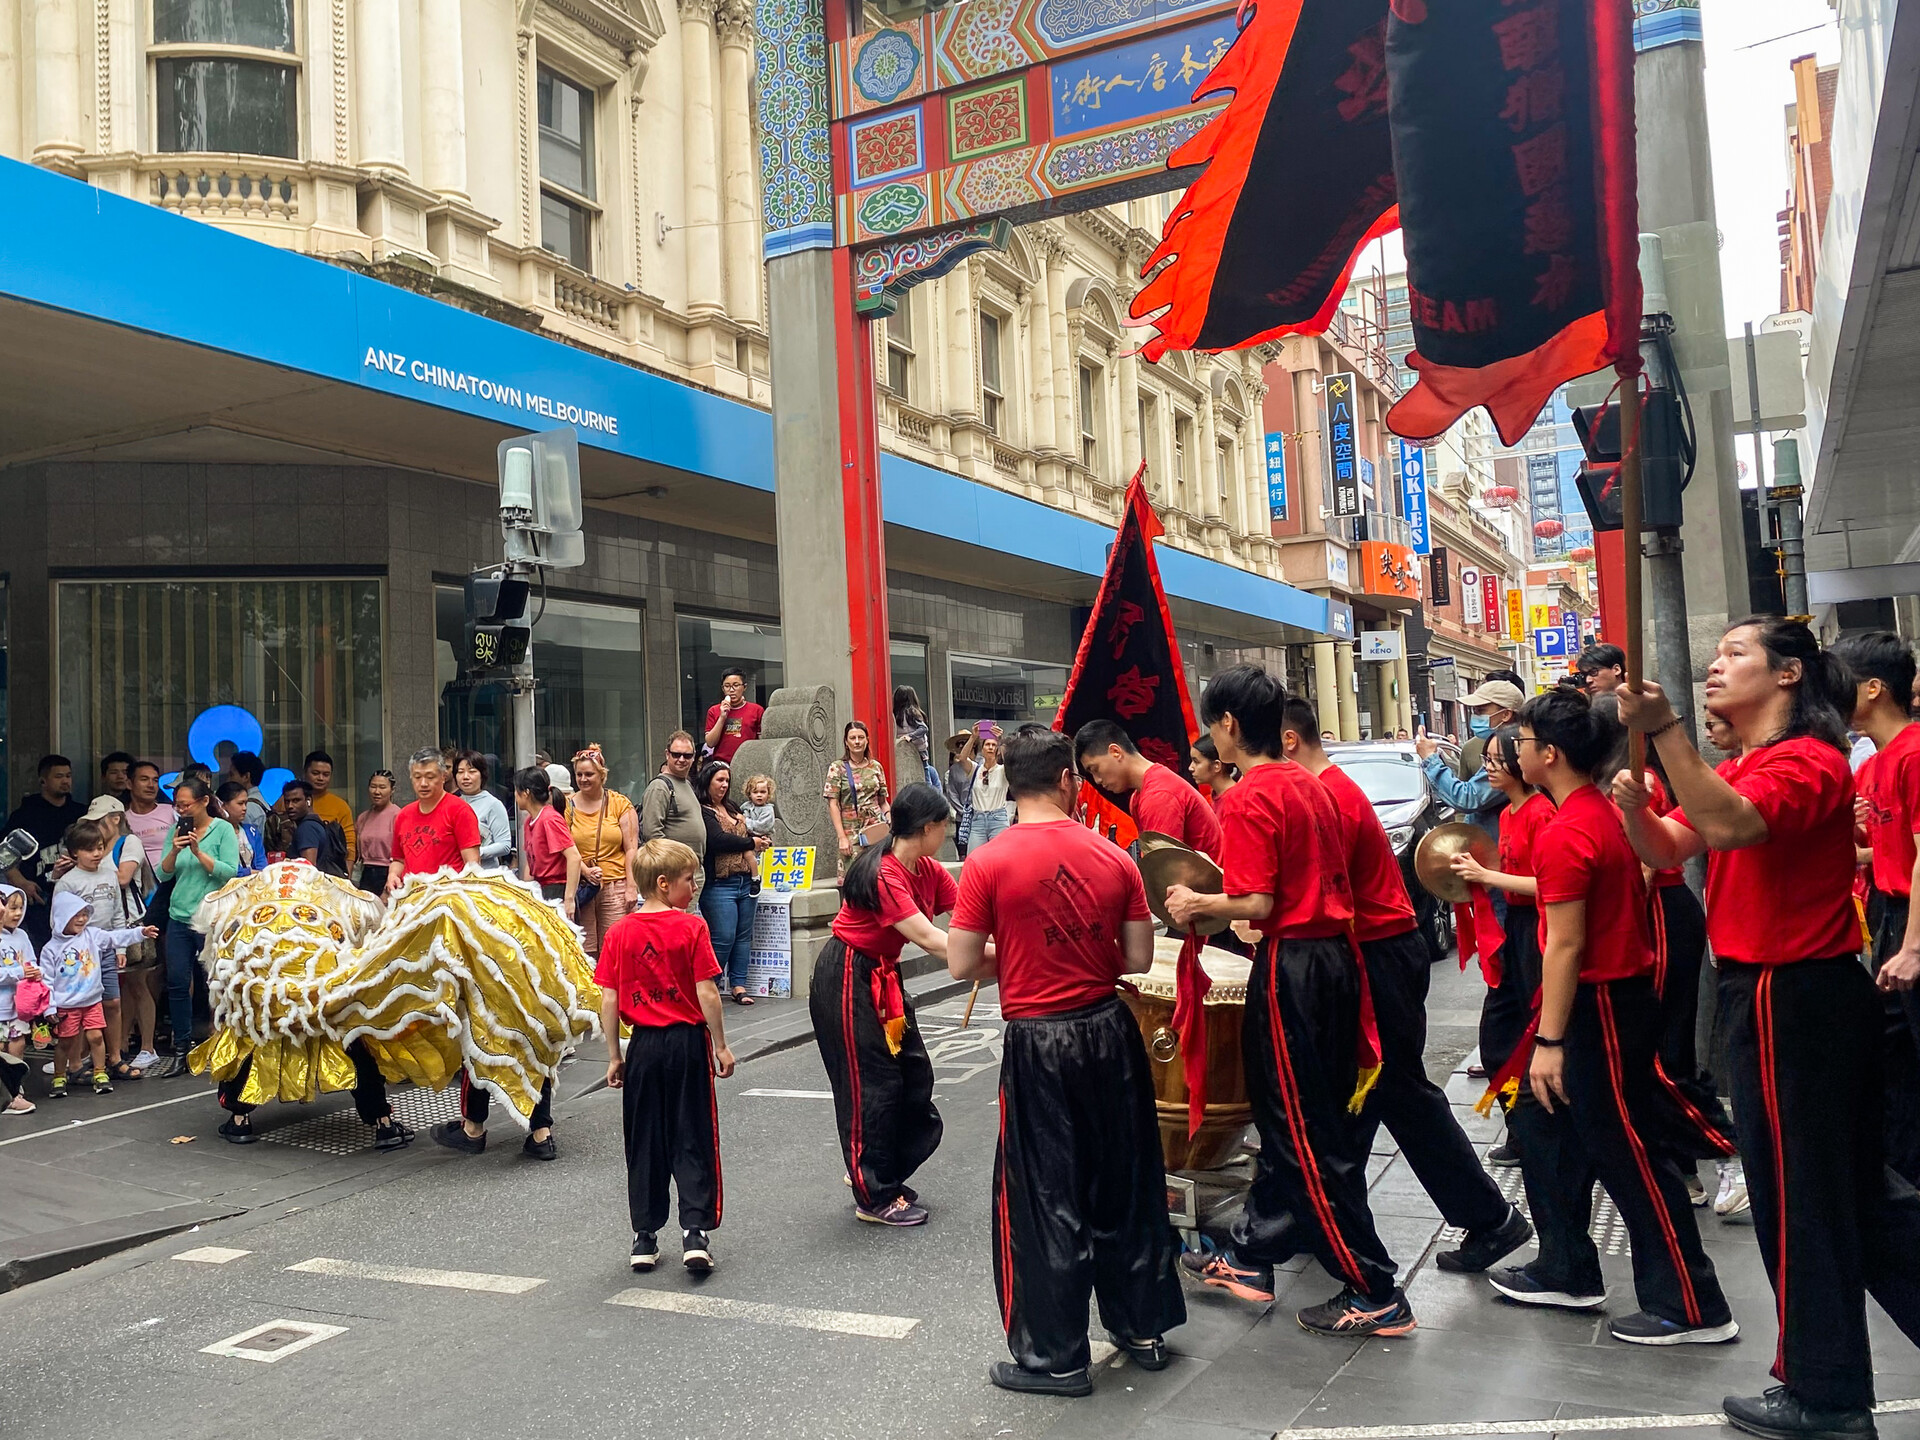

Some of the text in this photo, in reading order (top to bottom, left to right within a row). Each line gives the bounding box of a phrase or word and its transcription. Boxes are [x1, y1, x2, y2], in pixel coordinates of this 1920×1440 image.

[1772, 317, 1802, 328] Korean
[364, 347, 618, 435] ANZ CHINATOWN MELBOURNE
[1332, 402, 1353, 481] 八度空間
[1404, 443, 1424, 546] POKIES
[1435, 557, 1444, 598] WORKSHOP
[1486, 577, 1496, 630] CRAZY WING
[1369, 647, 1392, 655] KENO
[1540, 630, 1560, 654] P
[772, 848, 807, 867] 天佑
[770, 869, 804, 888] 中华
[631, 986, 682, 1008] 民治党
